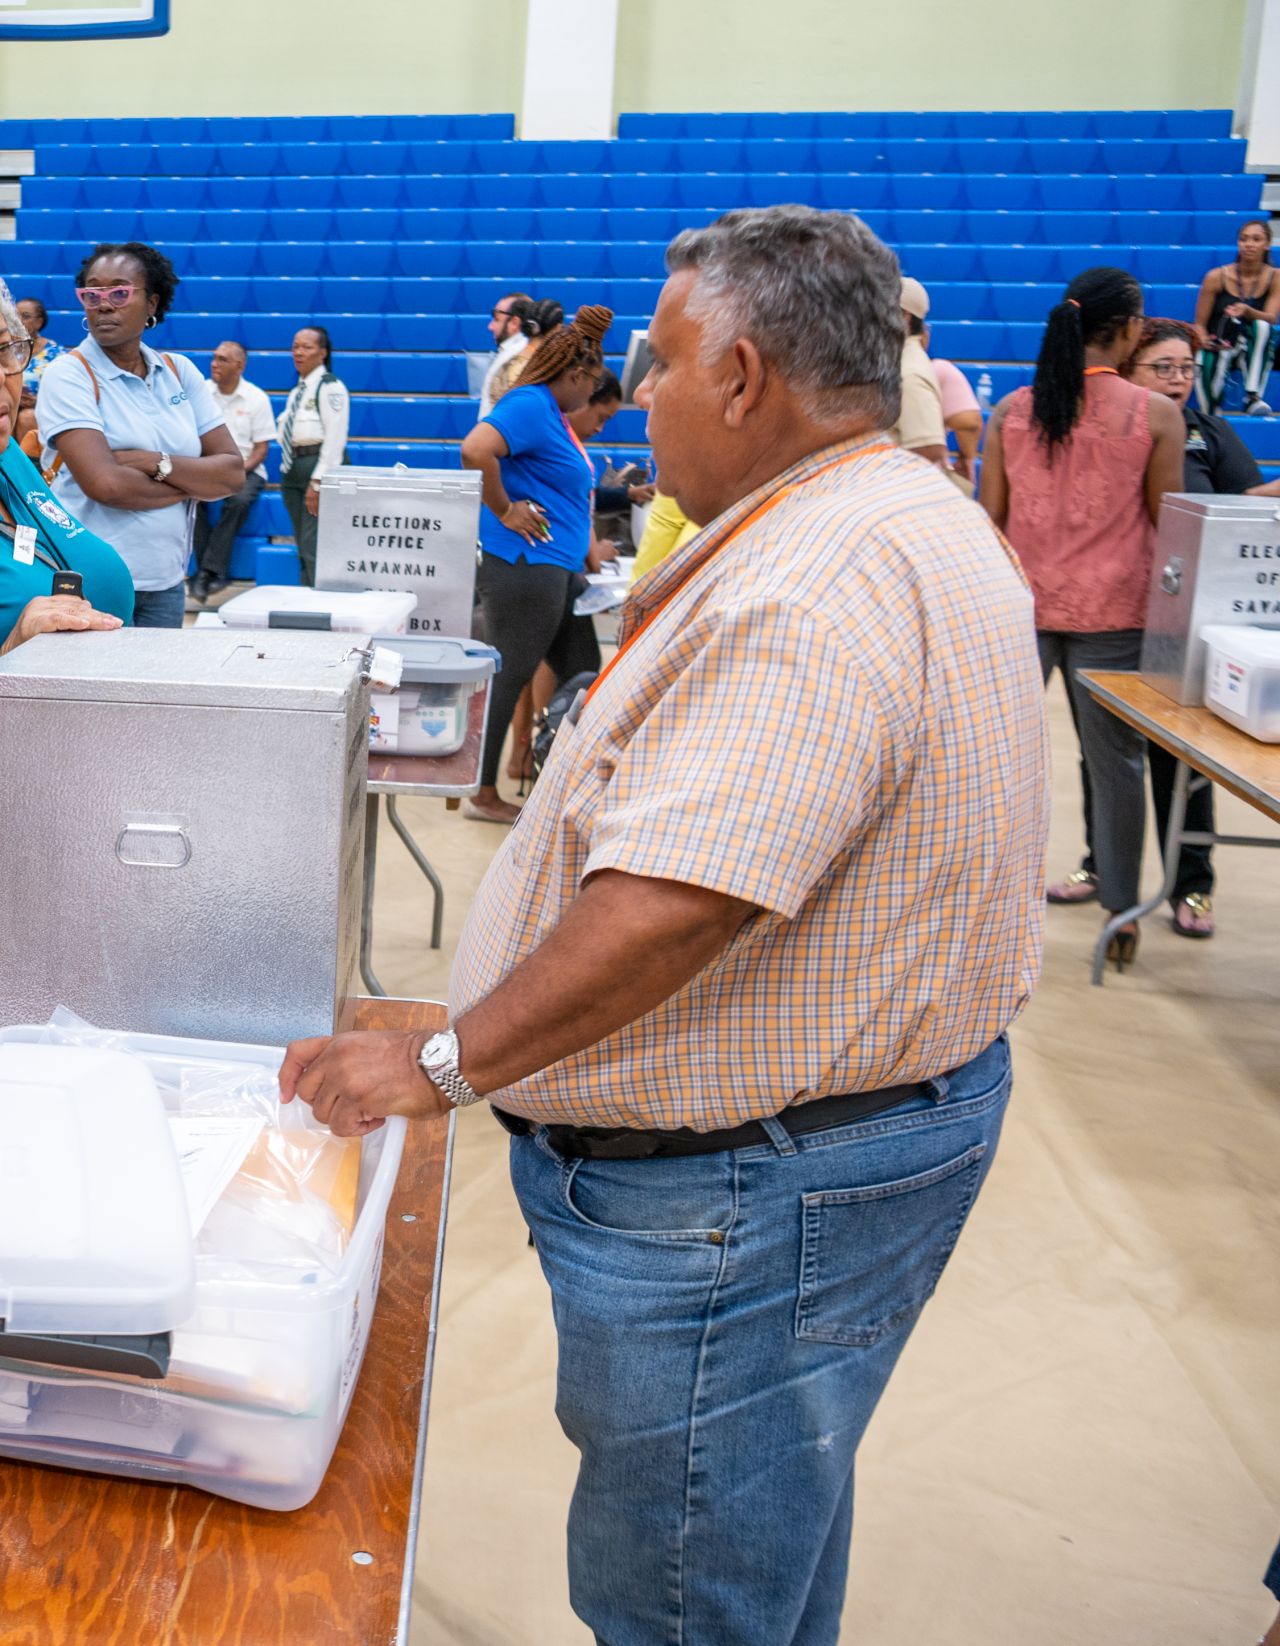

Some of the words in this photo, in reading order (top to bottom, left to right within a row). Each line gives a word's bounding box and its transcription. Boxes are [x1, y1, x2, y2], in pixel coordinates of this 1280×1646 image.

[352, 515, 442, 531] ELECTIONS
[367, 535, 424, 550] OFFICE
[347, 560, 435, 576] SAVANNAH
[410, 618, 442, 632] BOX
